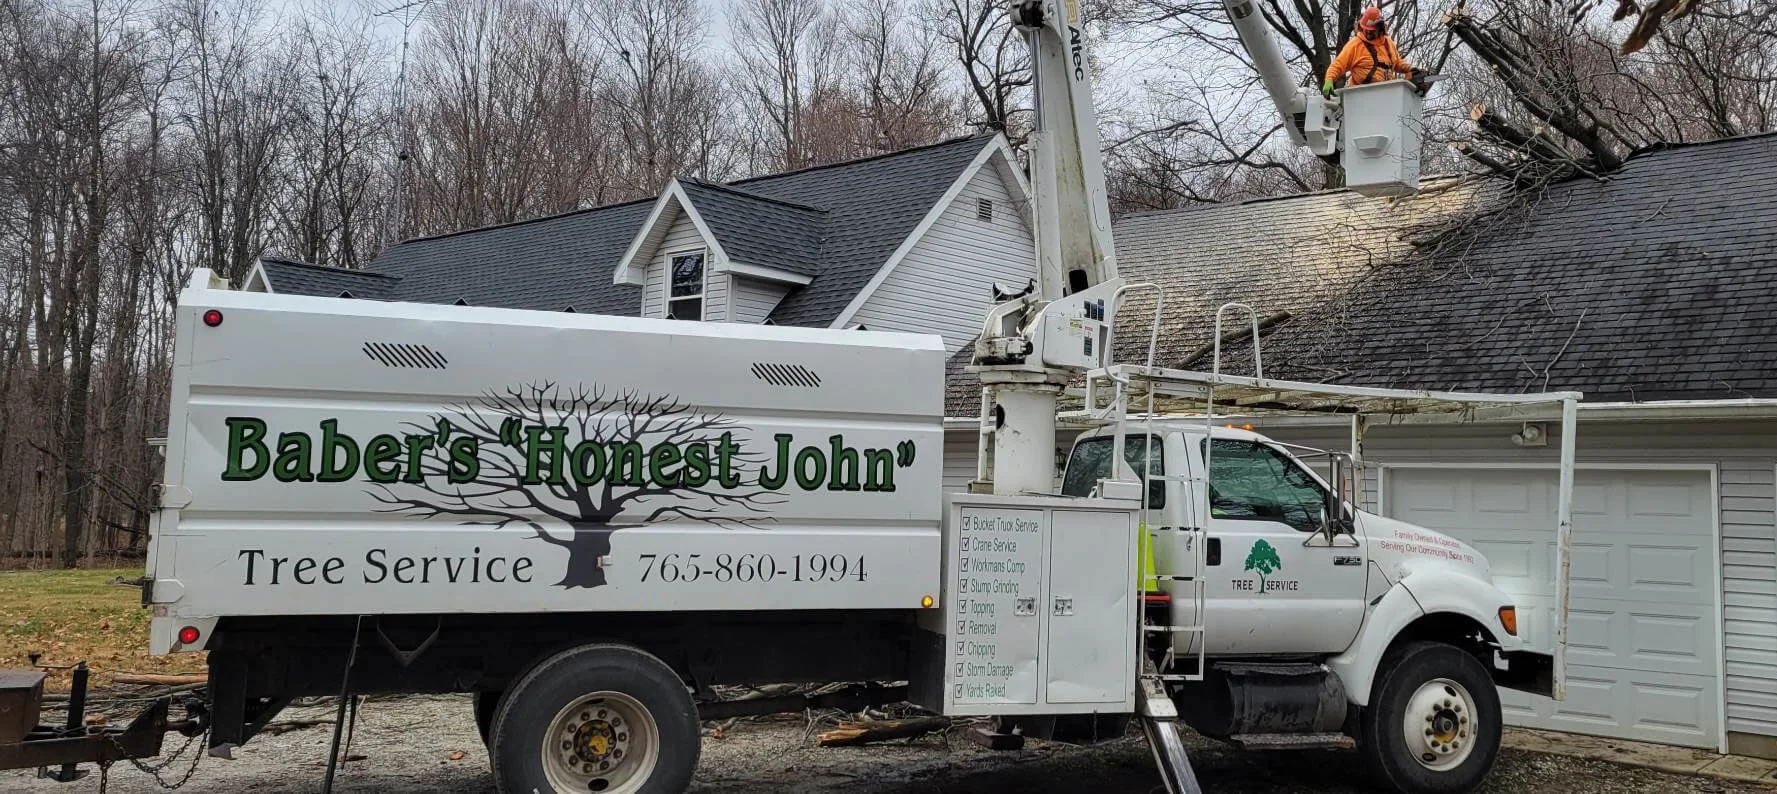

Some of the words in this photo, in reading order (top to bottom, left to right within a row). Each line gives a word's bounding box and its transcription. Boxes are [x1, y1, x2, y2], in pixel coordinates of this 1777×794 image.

[1068, 25, 1084, 82] Altec
[221, 417, 481, 484] Baber’s
[973, 516, 995, 531] Bucket
[997, 517, 1013, 532] Truck
[1015, 518, 1039, 533] Service
[973, 537, 992, 551] Crane
[994, 537, 1017, 552] Service
[1381, 541, 1404, 553] Serving
[1405, 543, 1417, 553] Our
[1418, 545, 1448, 560] Community
[238, 549, 345, 586] Tree
[363, 547, 534, 585] Service
[638, 552, 868, 583] 765-860-1994
[971, 557, 1004, 573] Workmans
[1006, 558, 1025, 576] Comp
[970, 578, 991, 596] Stump
[993, 578, 1019, 597] Grinding
[1231, 580, 1253, 590] TREE
[1266, 580, 1298, 591] SERVICE
[970, 600, 995, 617] Topping
[968, 620, 996, 635] Removal
[968, 641, 996, 659] Chipping
[967, 662, 985, 677] Storm
[987, 662, 1014, 680] Damage
[966, 683, 984, 697] Yards
[985, 683, 1006, 697] Raked
